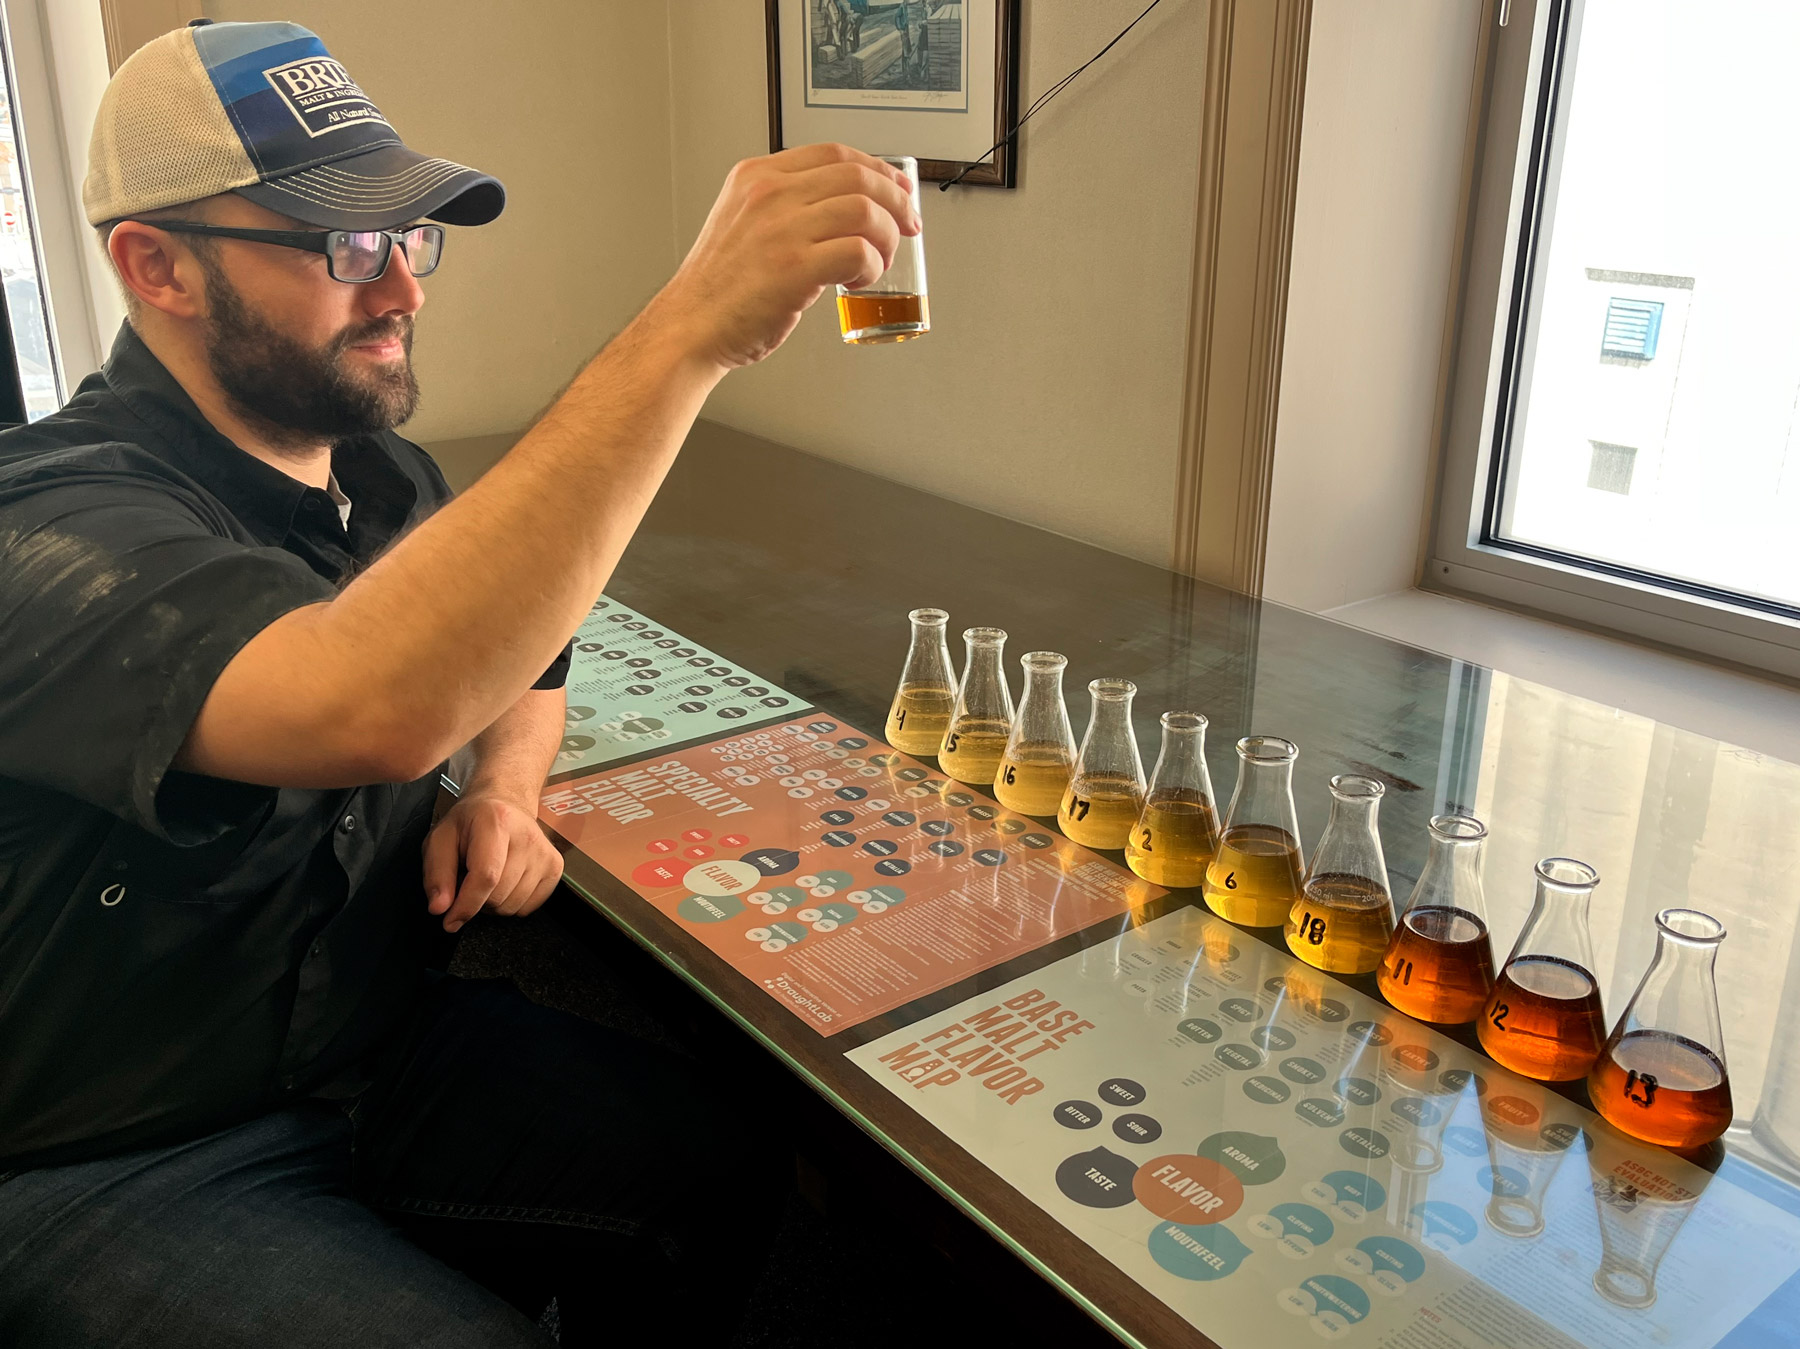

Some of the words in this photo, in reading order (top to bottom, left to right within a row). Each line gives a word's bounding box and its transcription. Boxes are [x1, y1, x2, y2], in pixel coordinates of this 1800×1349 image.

[300, 94, 325, 106] MALT
[328, 111, 340, 122] All
[945, 732, 960, 752] 15
[610, 769, 677, 801] MALT
[1002, 765, 1016, 785] 16
[646, 760, 754, 817] SPECIALTY
[541, 790, 594, 817] MAP
[574, 779, 654, 824] FLAVOR
[1068, 796, 1090, 821] 17
[828, 813, 845, 822] STALE
[1142, 828, 1152, 851] 2
[652, 866, 674, 879] TASTE
[756, 855, 780, 868] AROMA
[699, 865, 743, 890] FLAVOR
[1225, 872, 1237, 889] 6
[692, 895, 727, 918] MOUTHFEEL
[1299, 912, 1326, 945] 18
[1393, 959, 1412, 985] 11
[776, 980, 833, 1023] DraughtLab
[1230, 1003, 1251, 1018] SPICY
[1002, 988, 1096, 1044] BASE
[1490, 1000, 1509, 1031] 12
[962, 1005, 1061, 1062] MALT
[1186, 1023, 1214, 1040] ROTTEN
[877, 1041, 961, 1090] MAP
[921, 1023, 1045, 1106] FLAVOR
[1222, 1047, 1252, 1067] VEGETAL
[1400, 1049, 1432, 1067] EARTHY
[1286, 1061, 1319, 1080] SMOKEY
[1109, 1083, 1135, 1101] SWEET
[1248, 1078, 1285, 1102] MEDICINAL
[1345, 1083, 1370, 1099] WAXY
[1624, 1069, 1658, 1109] 13
[1064, 1106, 1091, 1124] BITTER
[1302, 1102, 1338, 1124] SOLVENT
[1403, 1103, 1428, 1120] STALE
[1498, 1101, 1529, 1119] FRUITY
[1126, 1121, 1148, 1137] SOUR
[1345, 1131, 1384, 1156] METALLIC
[1222, 1146, 1260, 1171] AROMA
[1084, 1167, 1117, 1192] TASTE
[1613, 1166, 1682, 1201] EVALUATION
[1622, 1160, 1653, 1178] ASBC
[1652, 1176, 1677, 1190] HOT
[1151, 1164, 1224, 1214] FLAVOR
[1287, 1215, 1314, 1233] CLOYING
[1165, 1226, 1226, 1271] MOUTHFEEL
[1375, 1249, 1404, 1269] COATING
[1345, 1256, 1361, 1267] LOW
[1377, 1276, 1397, 1291] SLICK
[1307, 1280, 1362, 1319] MOUTHWATERING
[1419, 1306, 1442, 1324] NOTES
